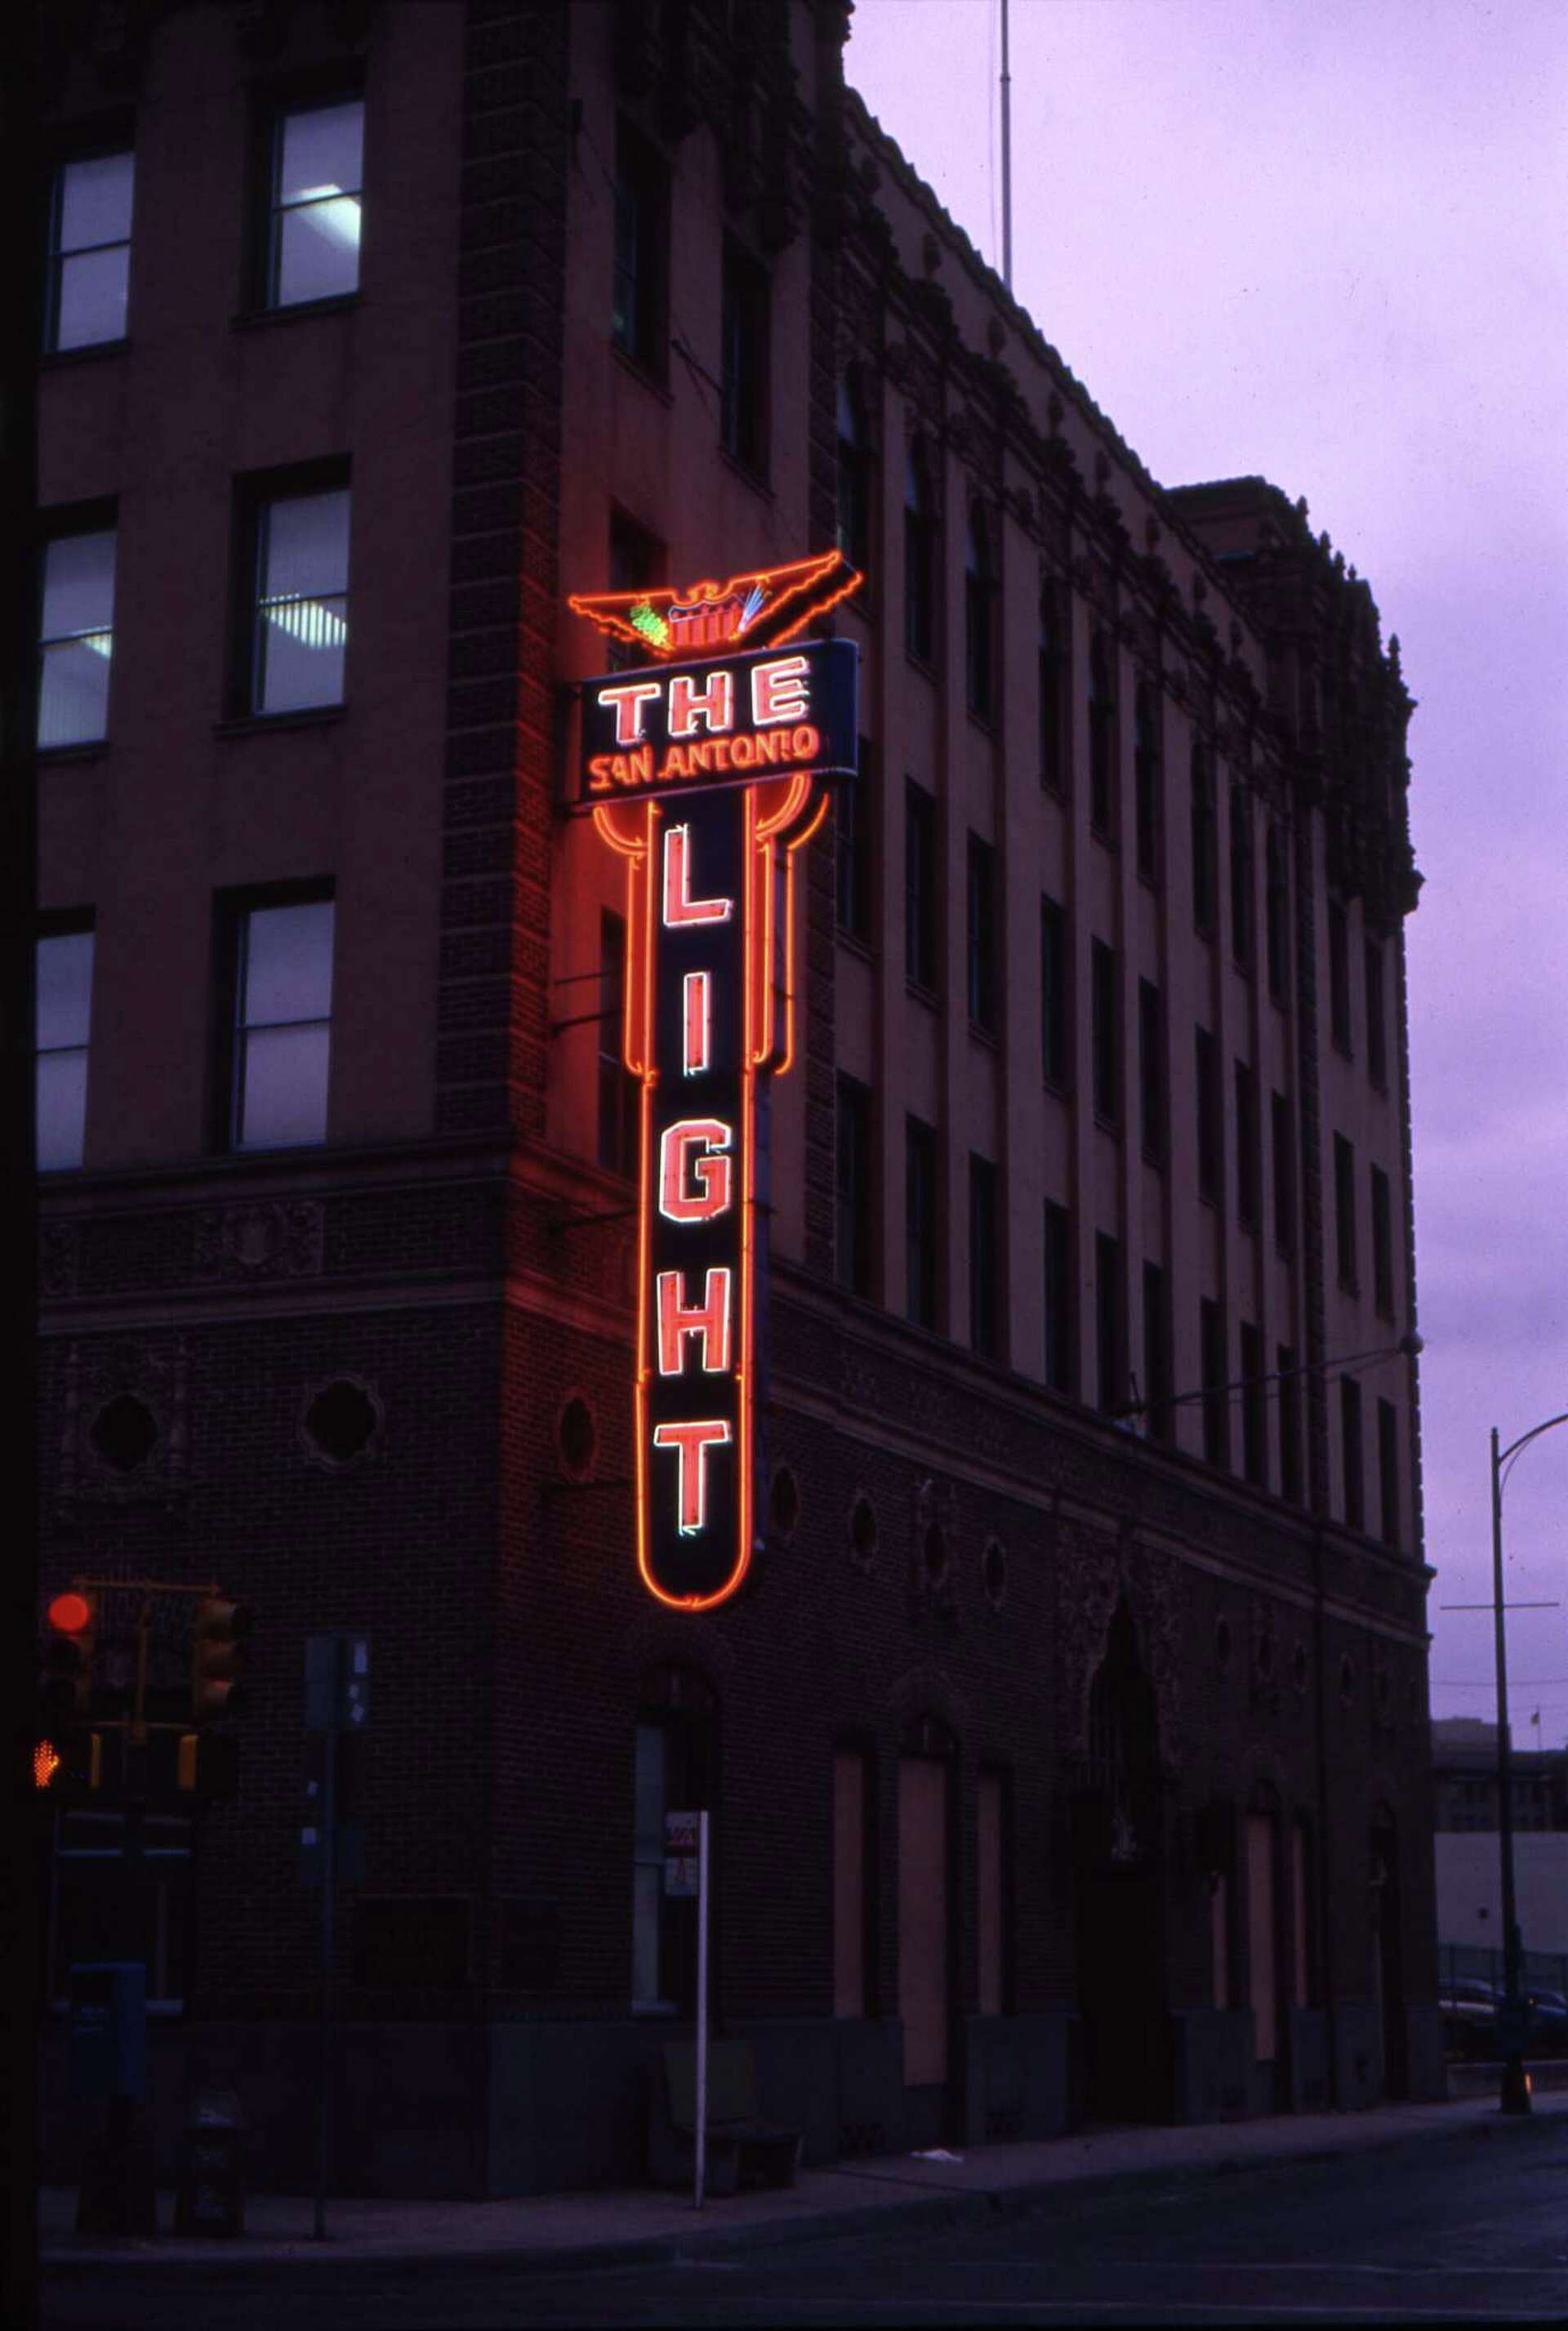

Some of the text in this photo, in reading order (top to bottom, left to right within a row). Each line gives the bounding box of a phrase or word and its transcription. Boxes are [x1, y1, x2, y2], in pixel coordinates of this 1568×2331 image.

[599, 657, 811, 746] THE
[588, 725, 819, 791] SAN ANTONIO
[654, 825, 733, 1535] LIGHT
